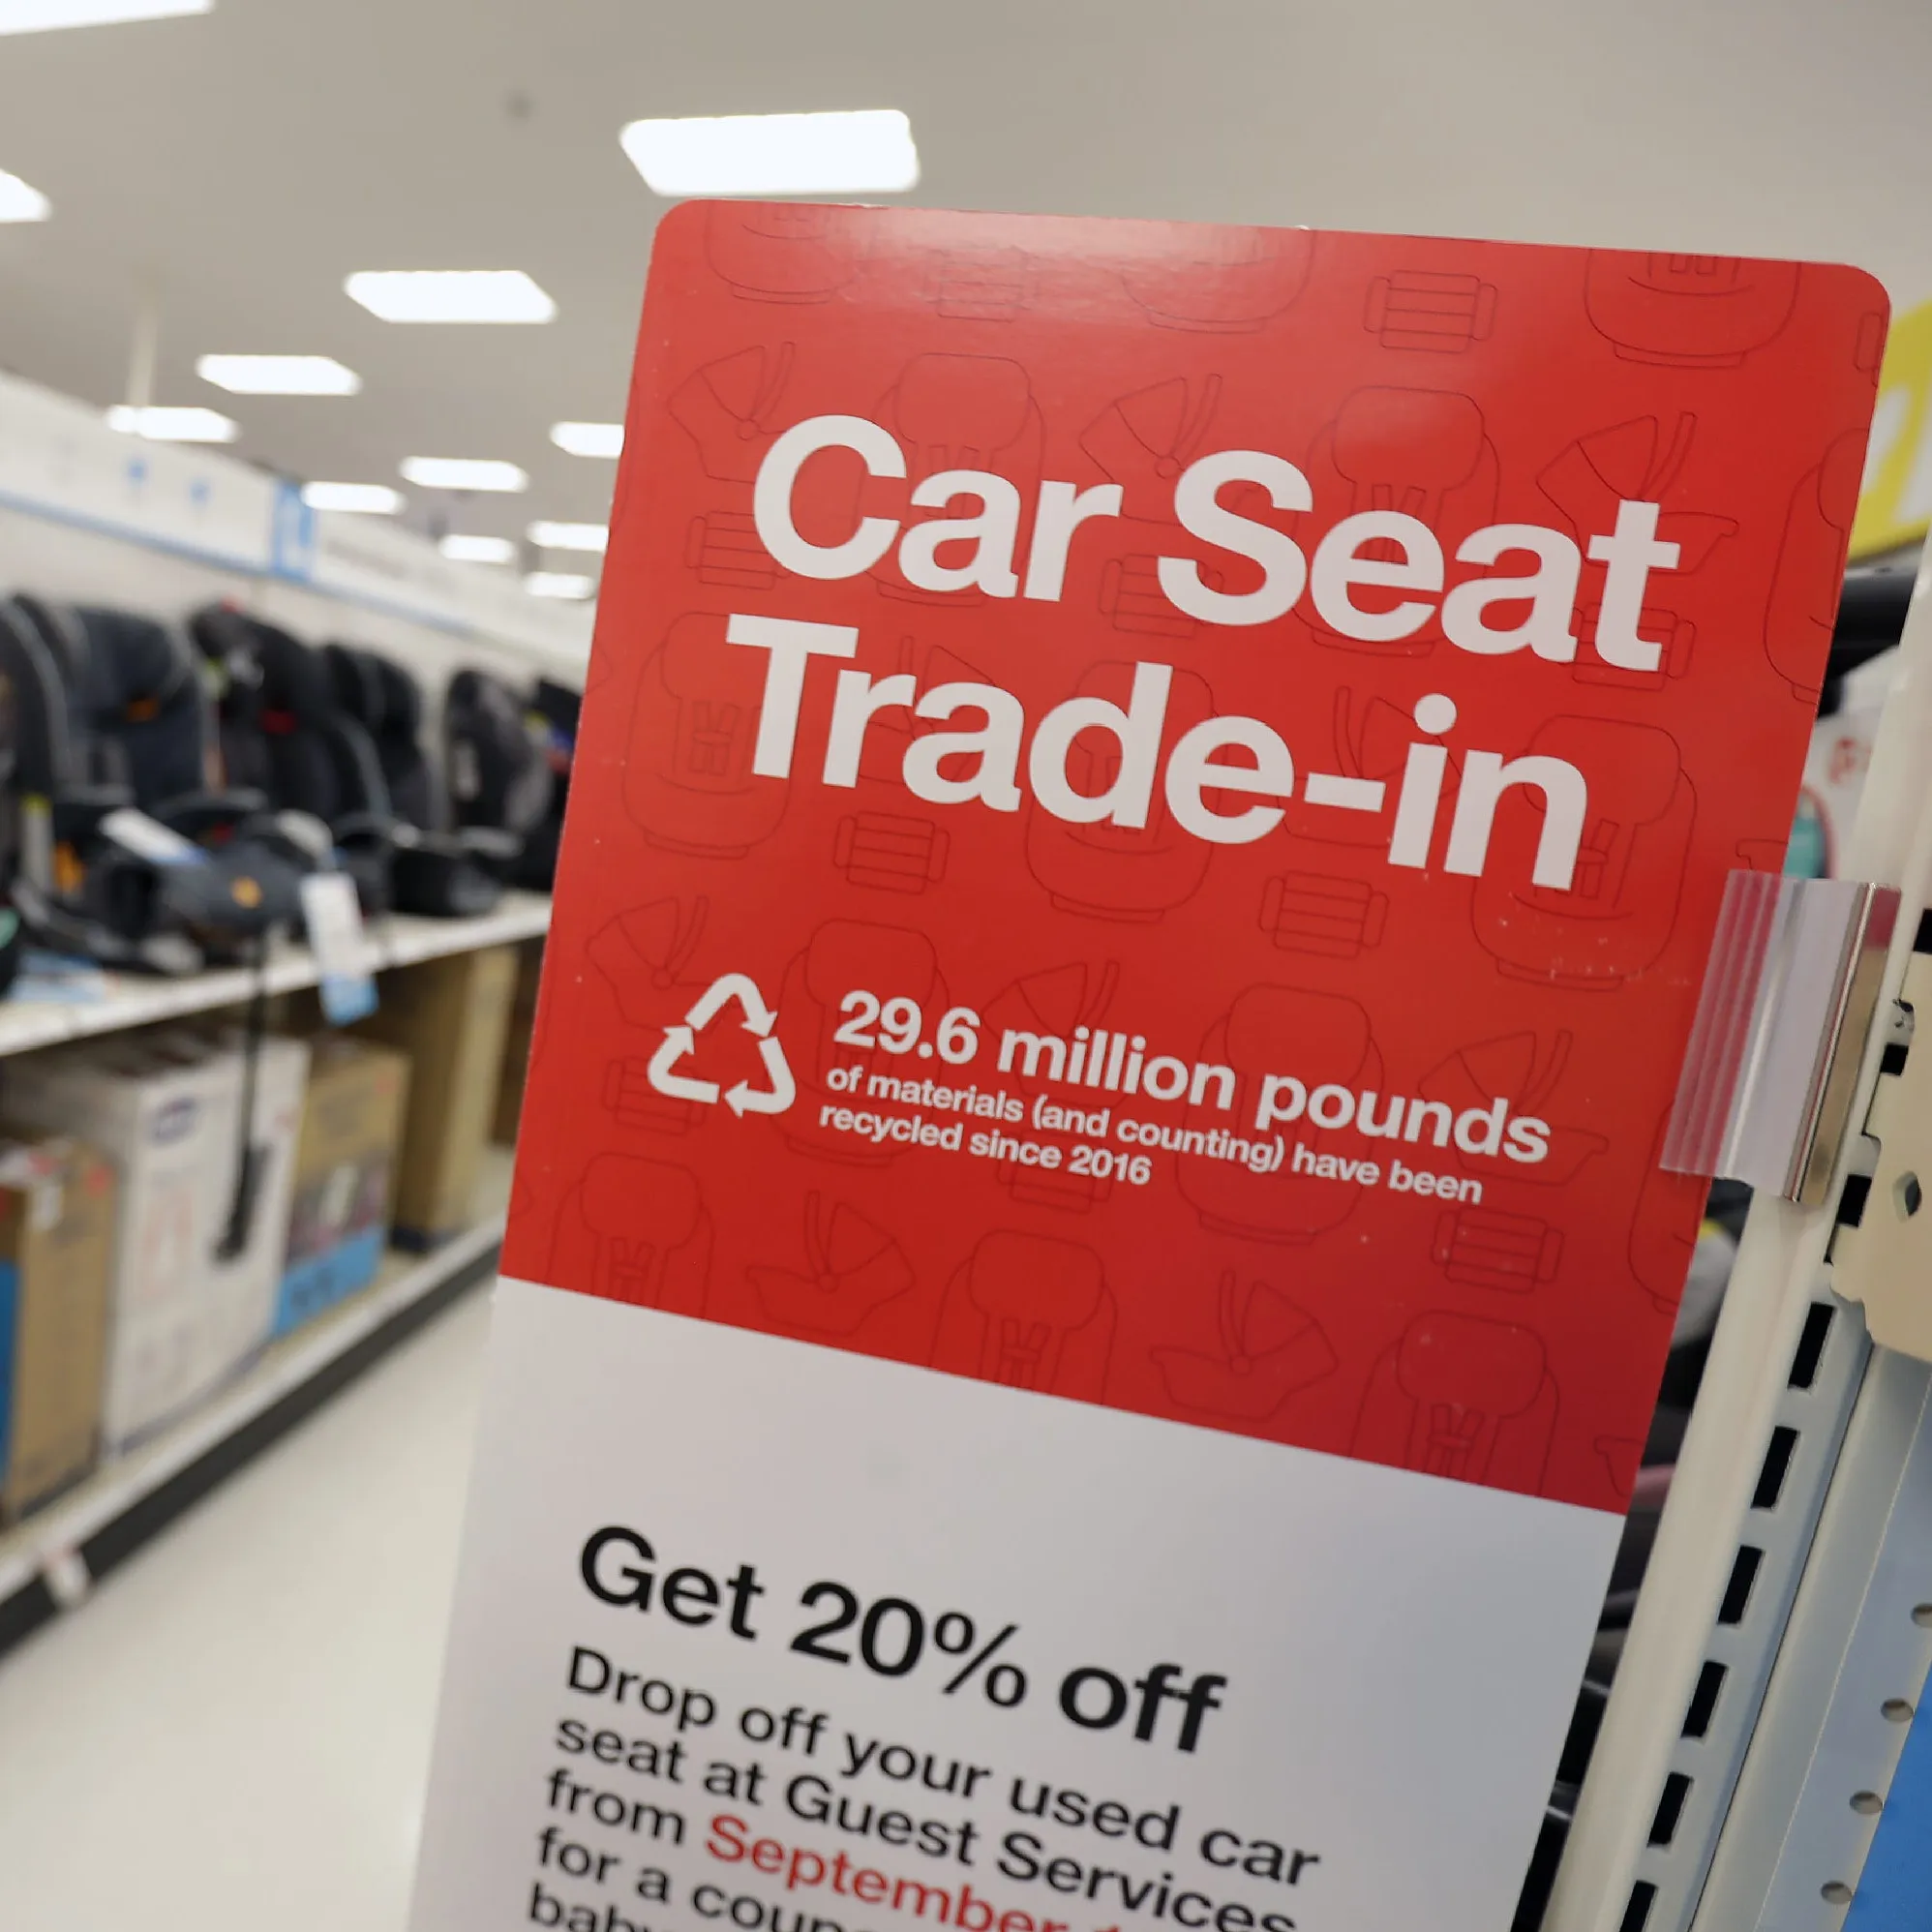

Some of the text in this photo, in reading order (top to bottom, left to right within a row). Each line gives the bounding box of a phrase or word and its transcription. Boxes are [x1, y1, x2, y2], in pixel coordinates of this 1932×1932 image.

[753, 415, 1123, 601] Car
[1158, 450, 1680, 671] Seat
[726, 614, 1586, 890] Trade-in
[821, 1106, 1151, 1184] recycled since 2016
[828, 1067, 1482, 1203] of materials (and counting) have been
[834, 991, 1550, 1162] 29.6 million pounds
[581, 1525, 1228, 1754] Get 20% off
[548, 1767, 686, 1847] from
[557, 1719, 685, 1784] seat
[702, 1761, 766, 1807] at
[784, 1773, 979, 1867] Guest
[567, 1645, 1321, 1887] Drop off your used car
[528, 1881, 650, 1932] bab
[538, 1826, 620, 1884] for
[636, 1866, 671, 1905] a
